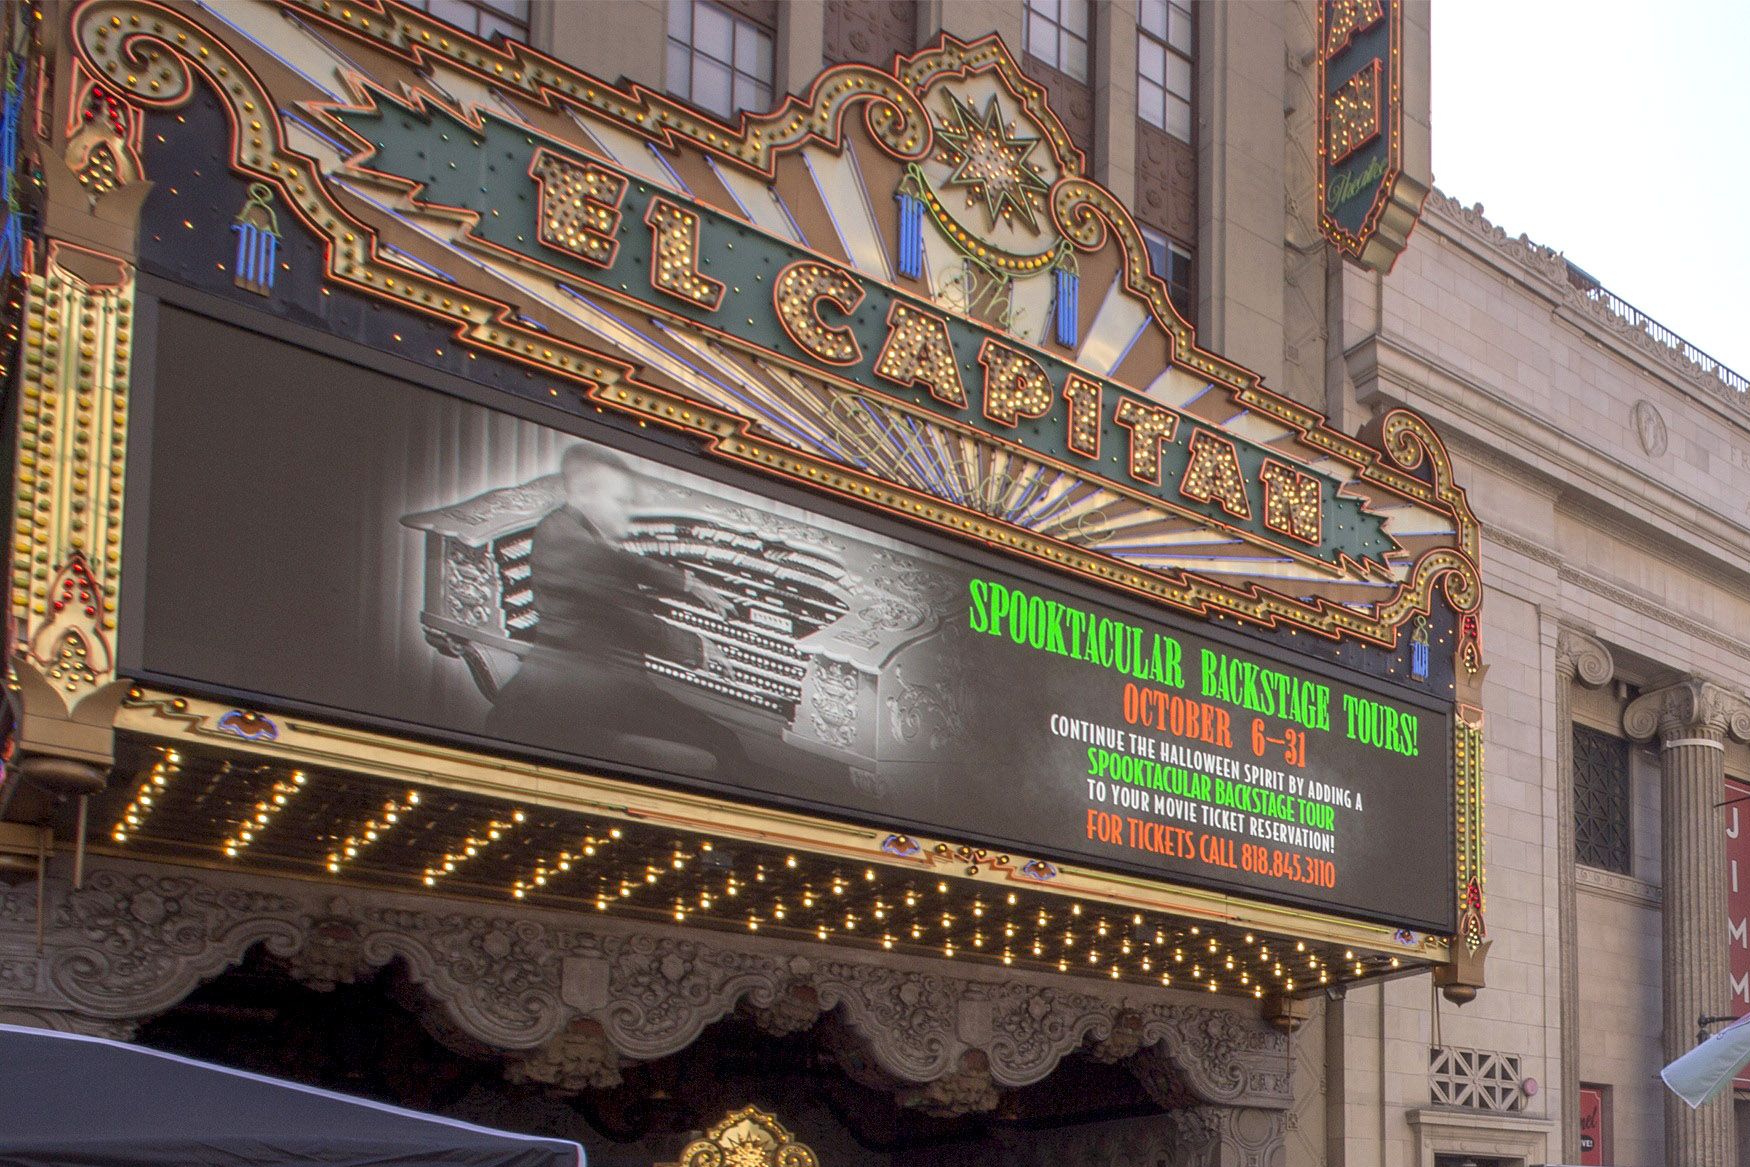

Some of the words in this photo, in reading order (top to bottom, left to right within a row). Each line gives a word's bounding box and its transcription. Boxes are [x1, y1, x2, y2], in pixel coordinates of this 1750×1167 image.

[528, 147, 727, 313] EL
[773, 259, 1323, 547] CAPITAN
[969, 578, 1185, 689] SPOOKTACULAR
[1200, 648, 1330, 732] BACKSTAGE
[1343, 694, 1419, 757] TOURS!
[1122, 682, 1233, 749] OCTOBER
[1050, 713, 1126, 752] CONTINUE
[1128, 733, 1156, 759] THE
[1160, 741, 1240, 781] HALLOWEEN
[1244, 763, 1285, 792] SPIRIT
[1288, 775, 1304, 796] BY
[1308, 780, 1352, 809] ADDING
[1355, 792, 1363, 811] A
[1087, 747, 1212, 802] SPOOKTACULAR
[1215, 778, 1295, 822] BACKSTAGE
[1297, 799, 1335, 831] TOUR
[1086, 808, 1123, 846] FOR
[1127, 817, 1196, 860] TICKETS
[1200, 834, 1238, 869] CALL
[1241, 843, 1336, 889] 818.845.3110
[1087, 778, 1106, 802] TO
[1111, 784, 1150, 813] YOUR
[1154, 794, 1197, 823] MOVIE
[1200, 805, 1245, 834] TICKET
[1249, 816, 1335, 853] RESERVATION!
